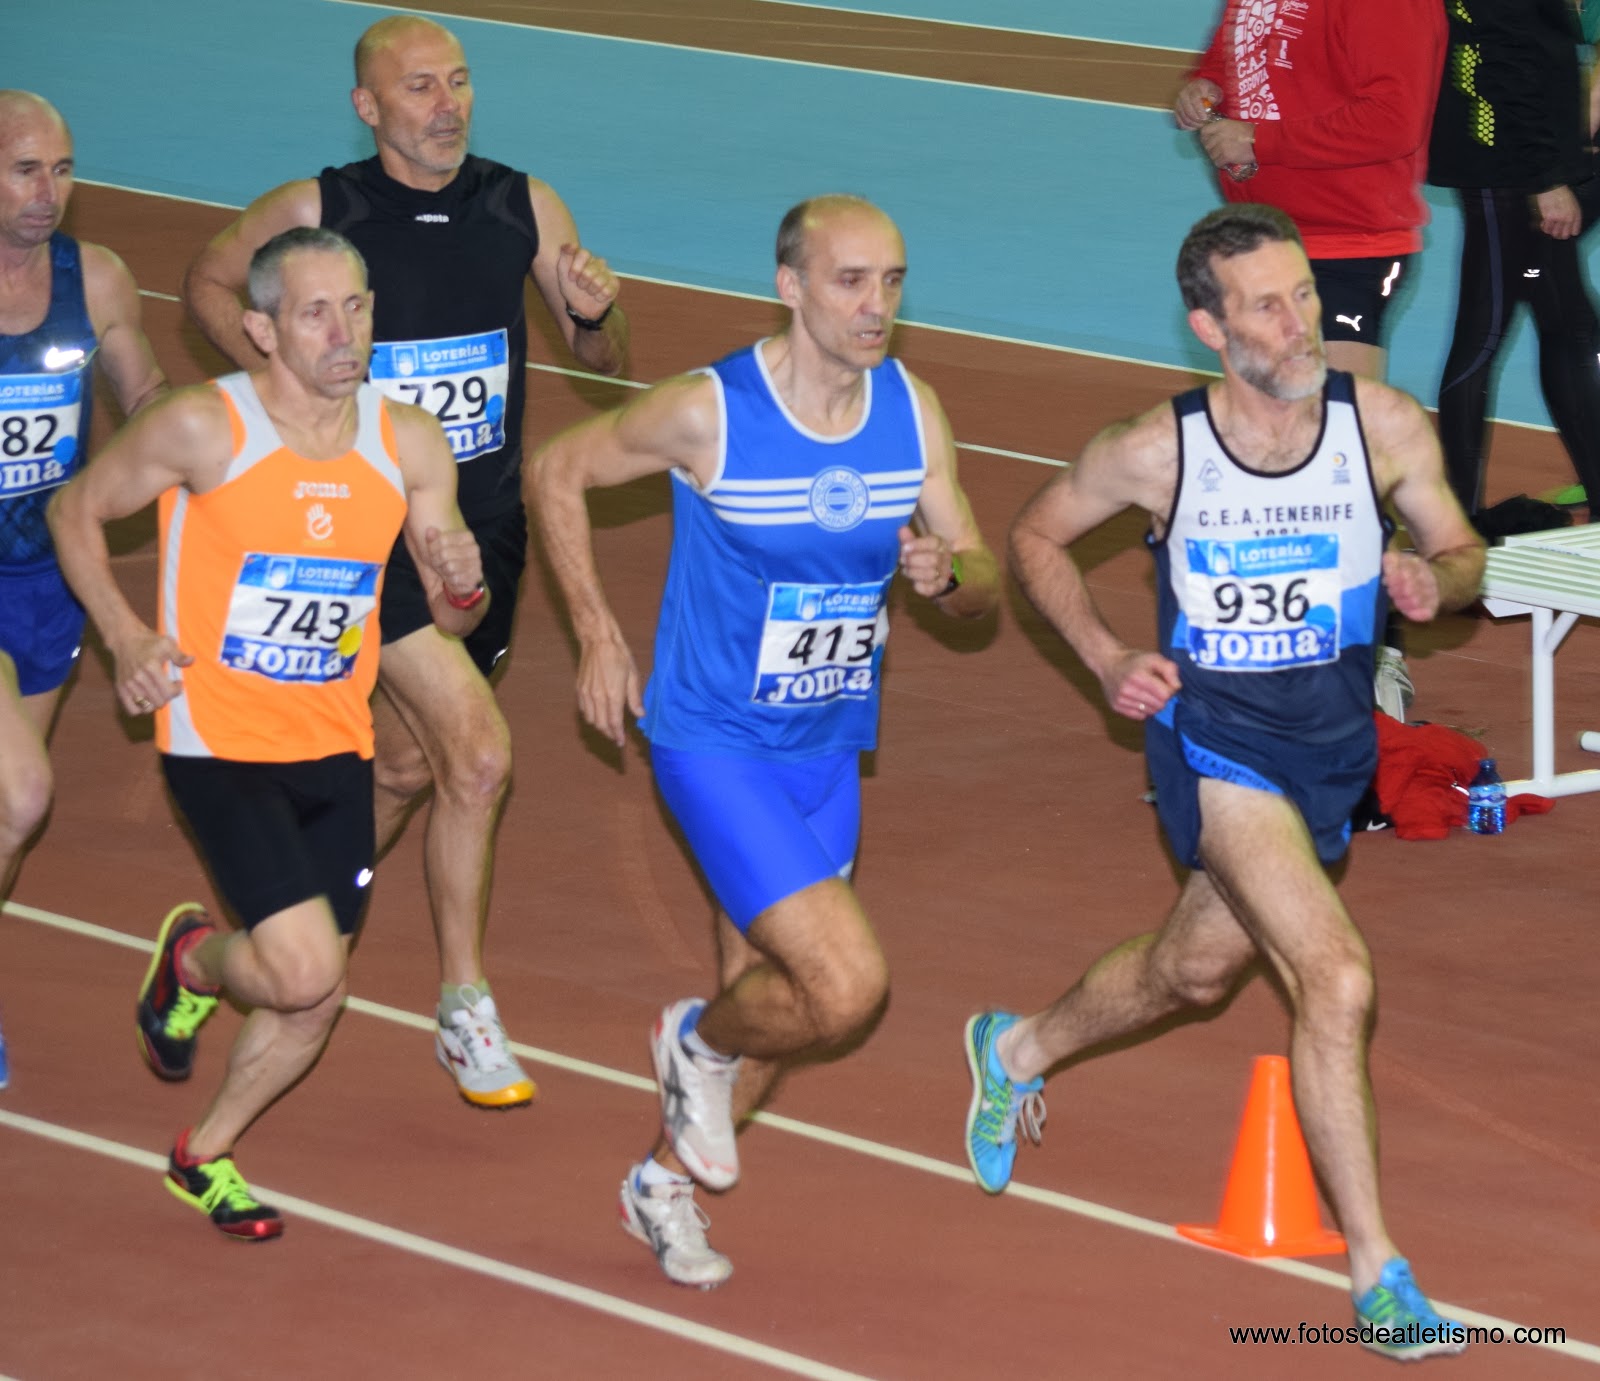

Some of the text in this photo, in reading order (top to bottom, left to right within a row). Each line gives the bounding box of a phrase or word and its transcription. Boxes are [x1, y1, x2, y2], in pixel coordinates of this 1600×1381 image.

[422, 344, 488, 363] LOTERÍAS
[399, 376, 489, 422] 729
[446, 421, 493, 453] ma
[0, 461, 65, 490] ma
[1239, 542, 1313, 563] LOTERÍAS
[262, 597, 350, 643] 743
[1213, 578, 1312, 626] 936
[788, 623, 876, 666] 413
